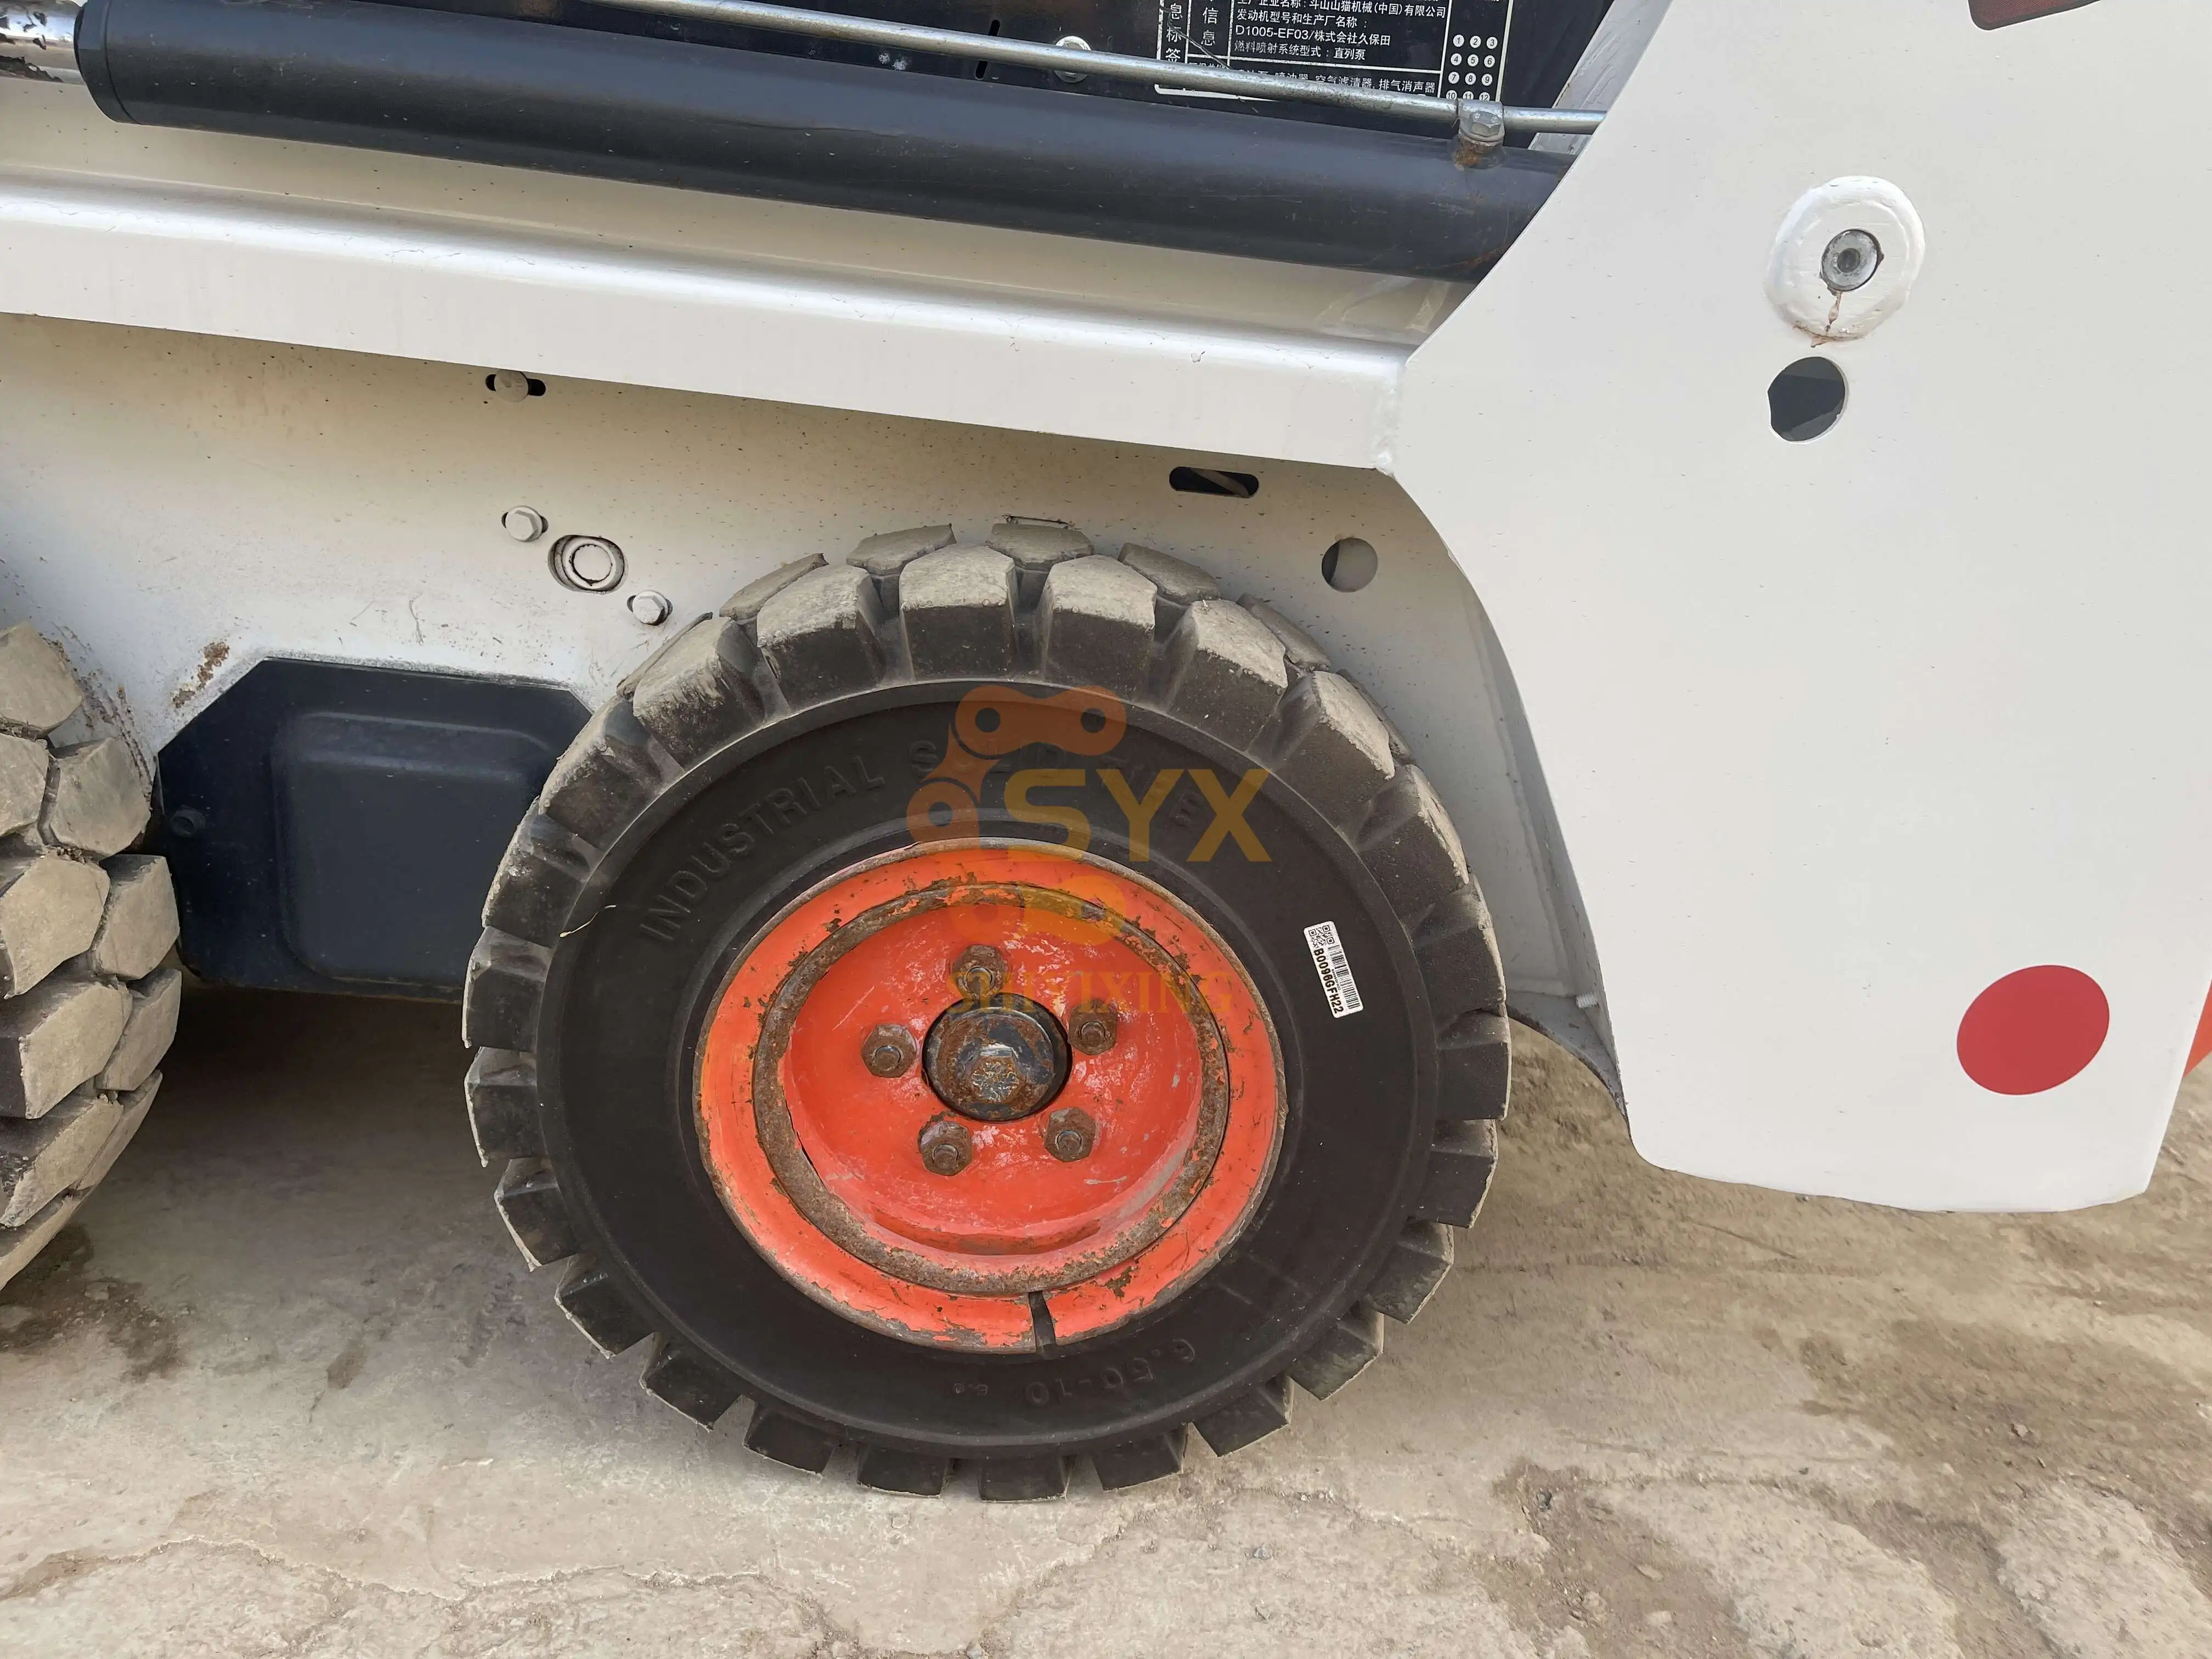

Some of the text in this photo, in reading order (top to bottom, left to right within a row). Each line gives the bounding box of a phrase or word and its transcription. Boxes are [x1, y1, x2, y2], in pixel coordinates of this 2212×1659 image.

[1201, 0, 1219, 47] 信息
[637, 754, 887, 943] INDUSTRIAL
[1313, 947, 1344, 1014] B0096GFH22
